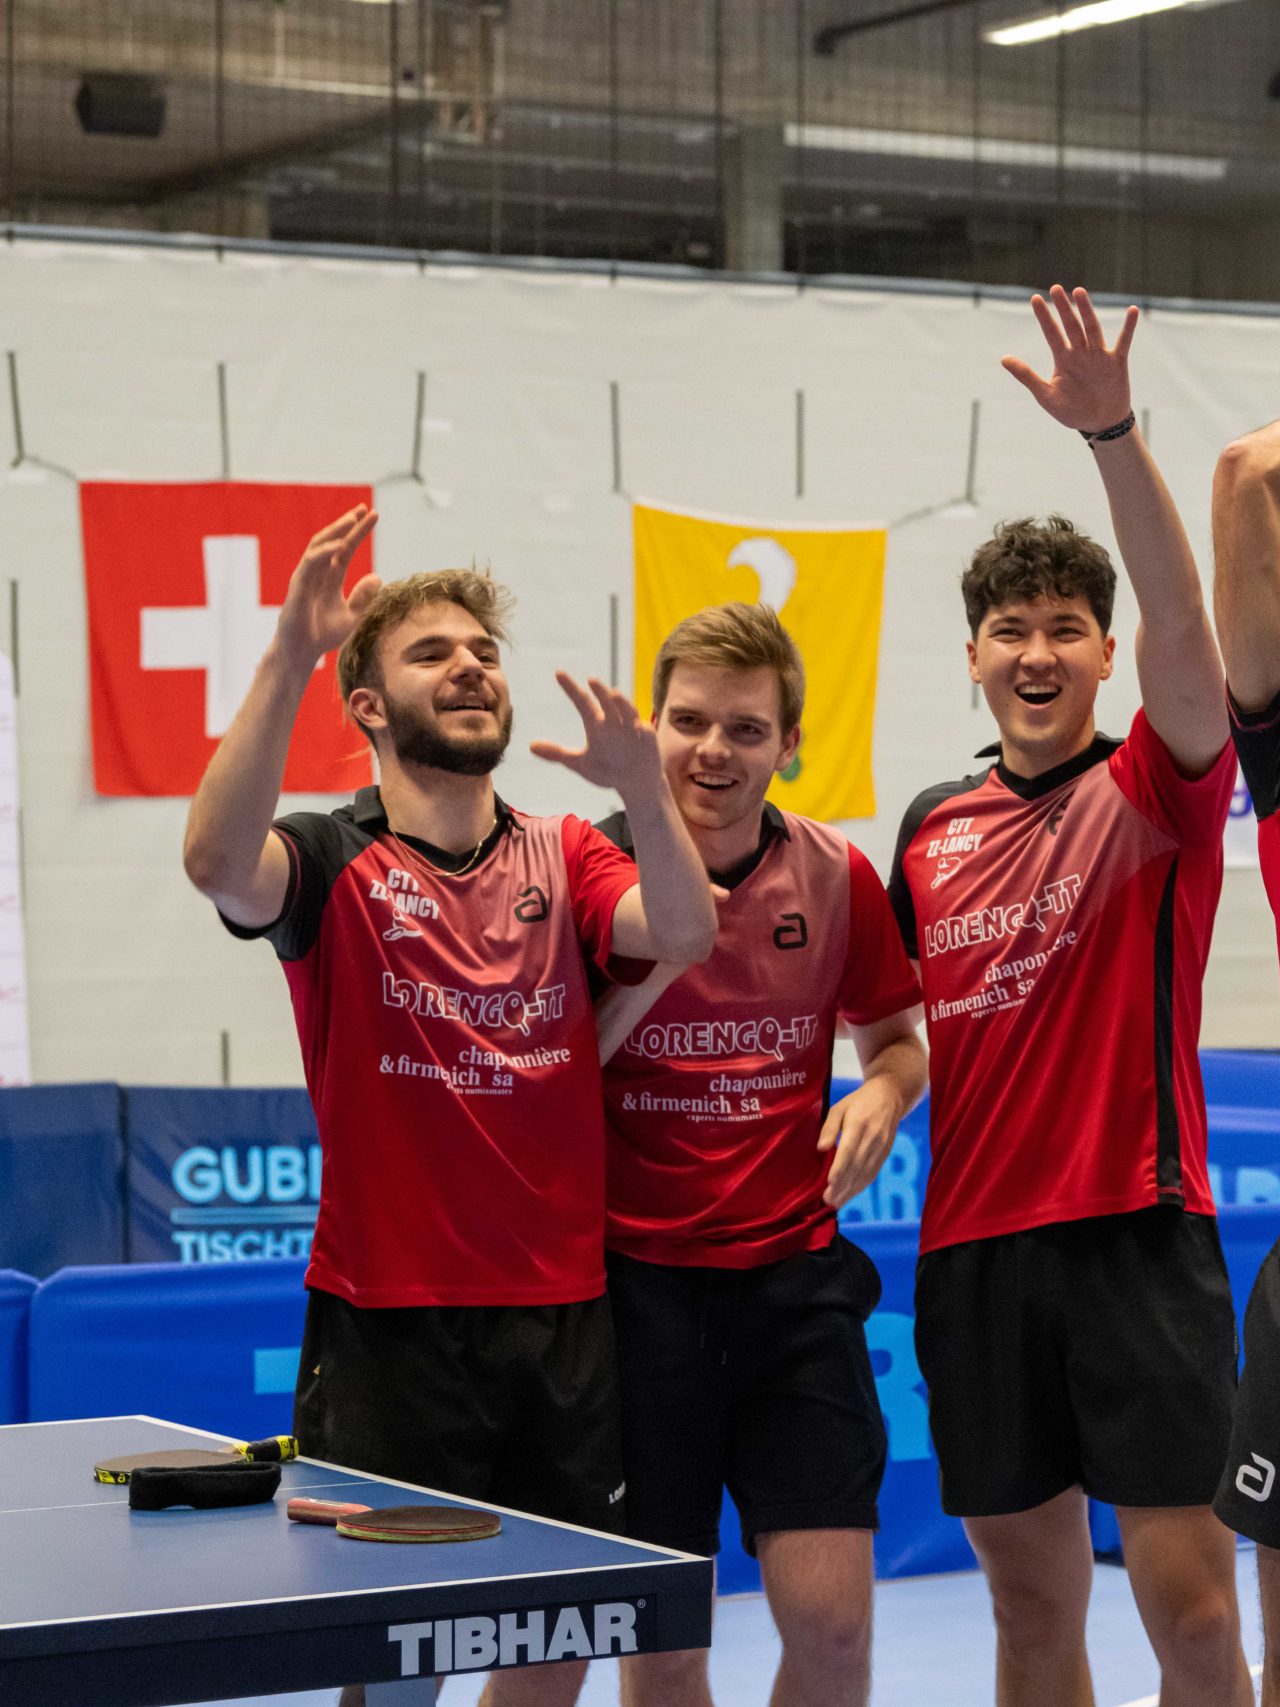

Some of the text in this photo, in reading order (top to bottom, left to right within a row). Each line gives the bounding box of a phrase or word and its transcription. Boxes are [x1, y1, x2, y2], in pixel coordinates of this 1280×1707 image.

[937, 983, 1010, 1020] firmenich
[379, 1054, 394, 1074] &
[492, 1072, 514, 1087] sa
[622, 1091, 761, 1115] & firmenich sa
